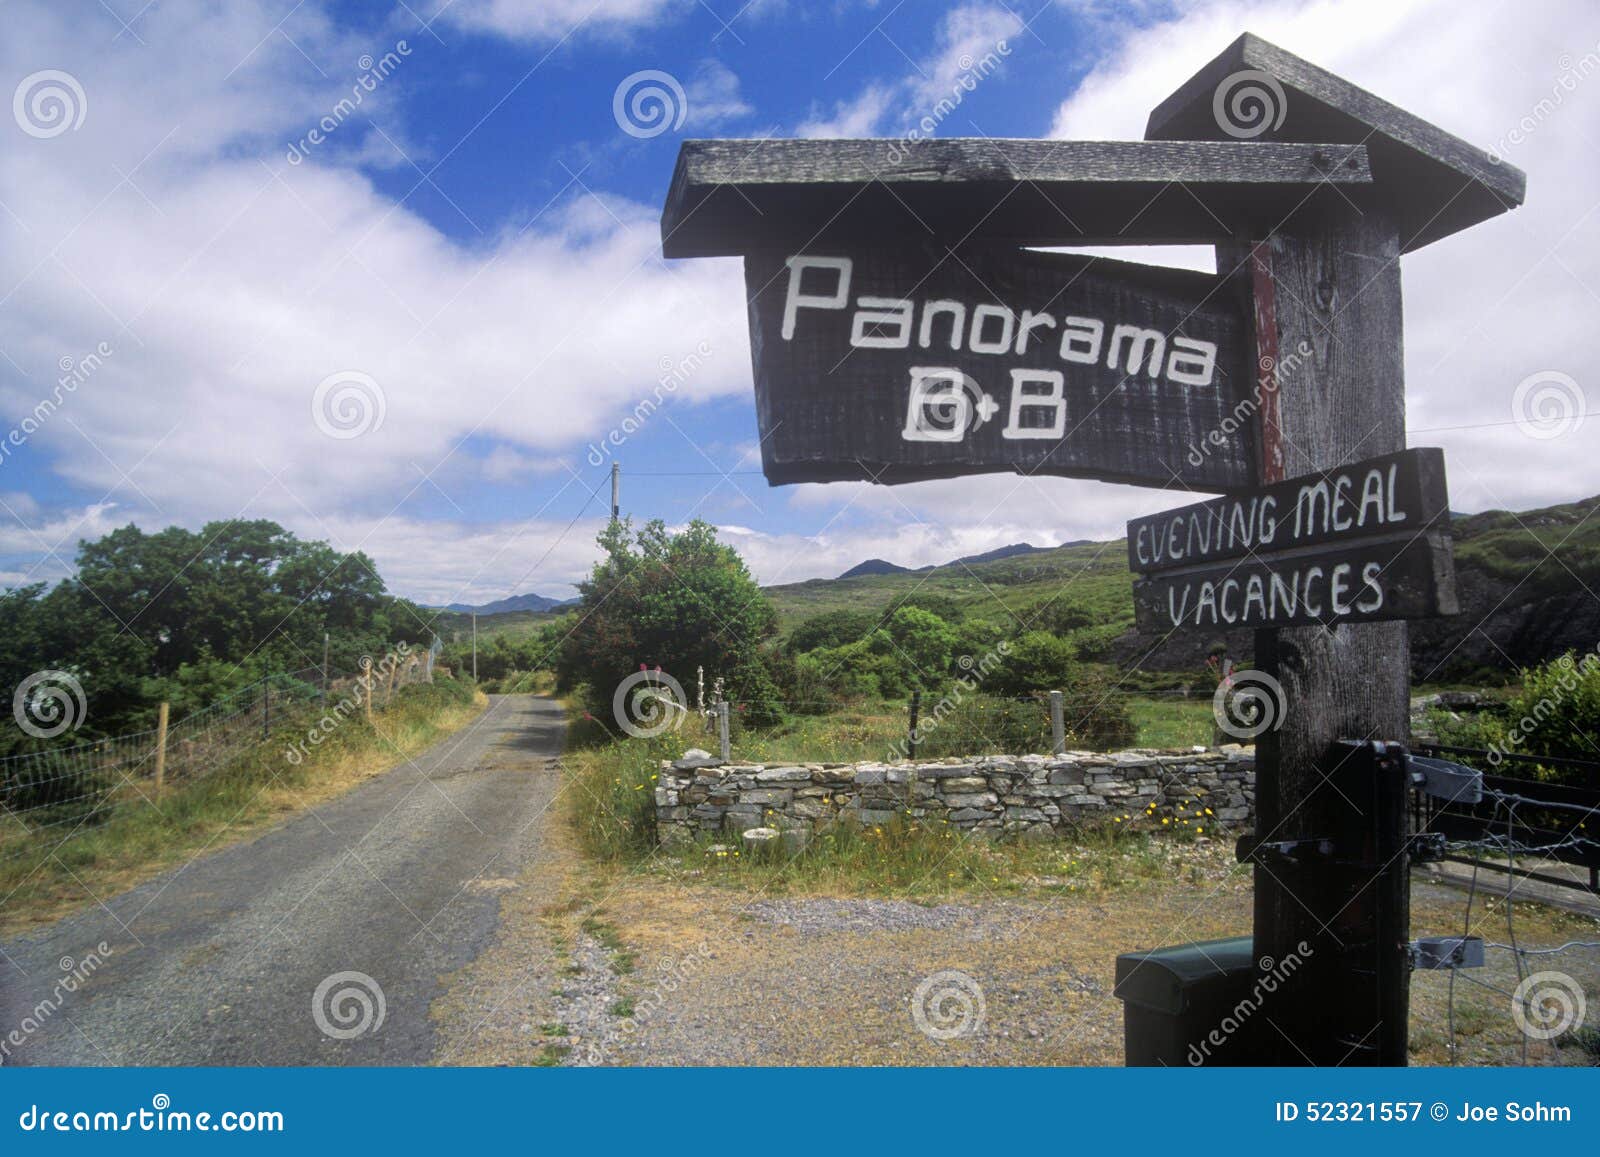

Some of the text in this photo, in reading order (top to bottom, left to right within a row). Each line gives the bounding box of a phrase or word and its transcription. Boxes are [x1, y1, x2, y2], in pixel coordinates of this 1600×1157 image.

[781, 256, 1217, 386] Panorama
[1136, 464, 1407, 564] EVENING MEAL
[1168, 562, 1384, 626] VACANCES
